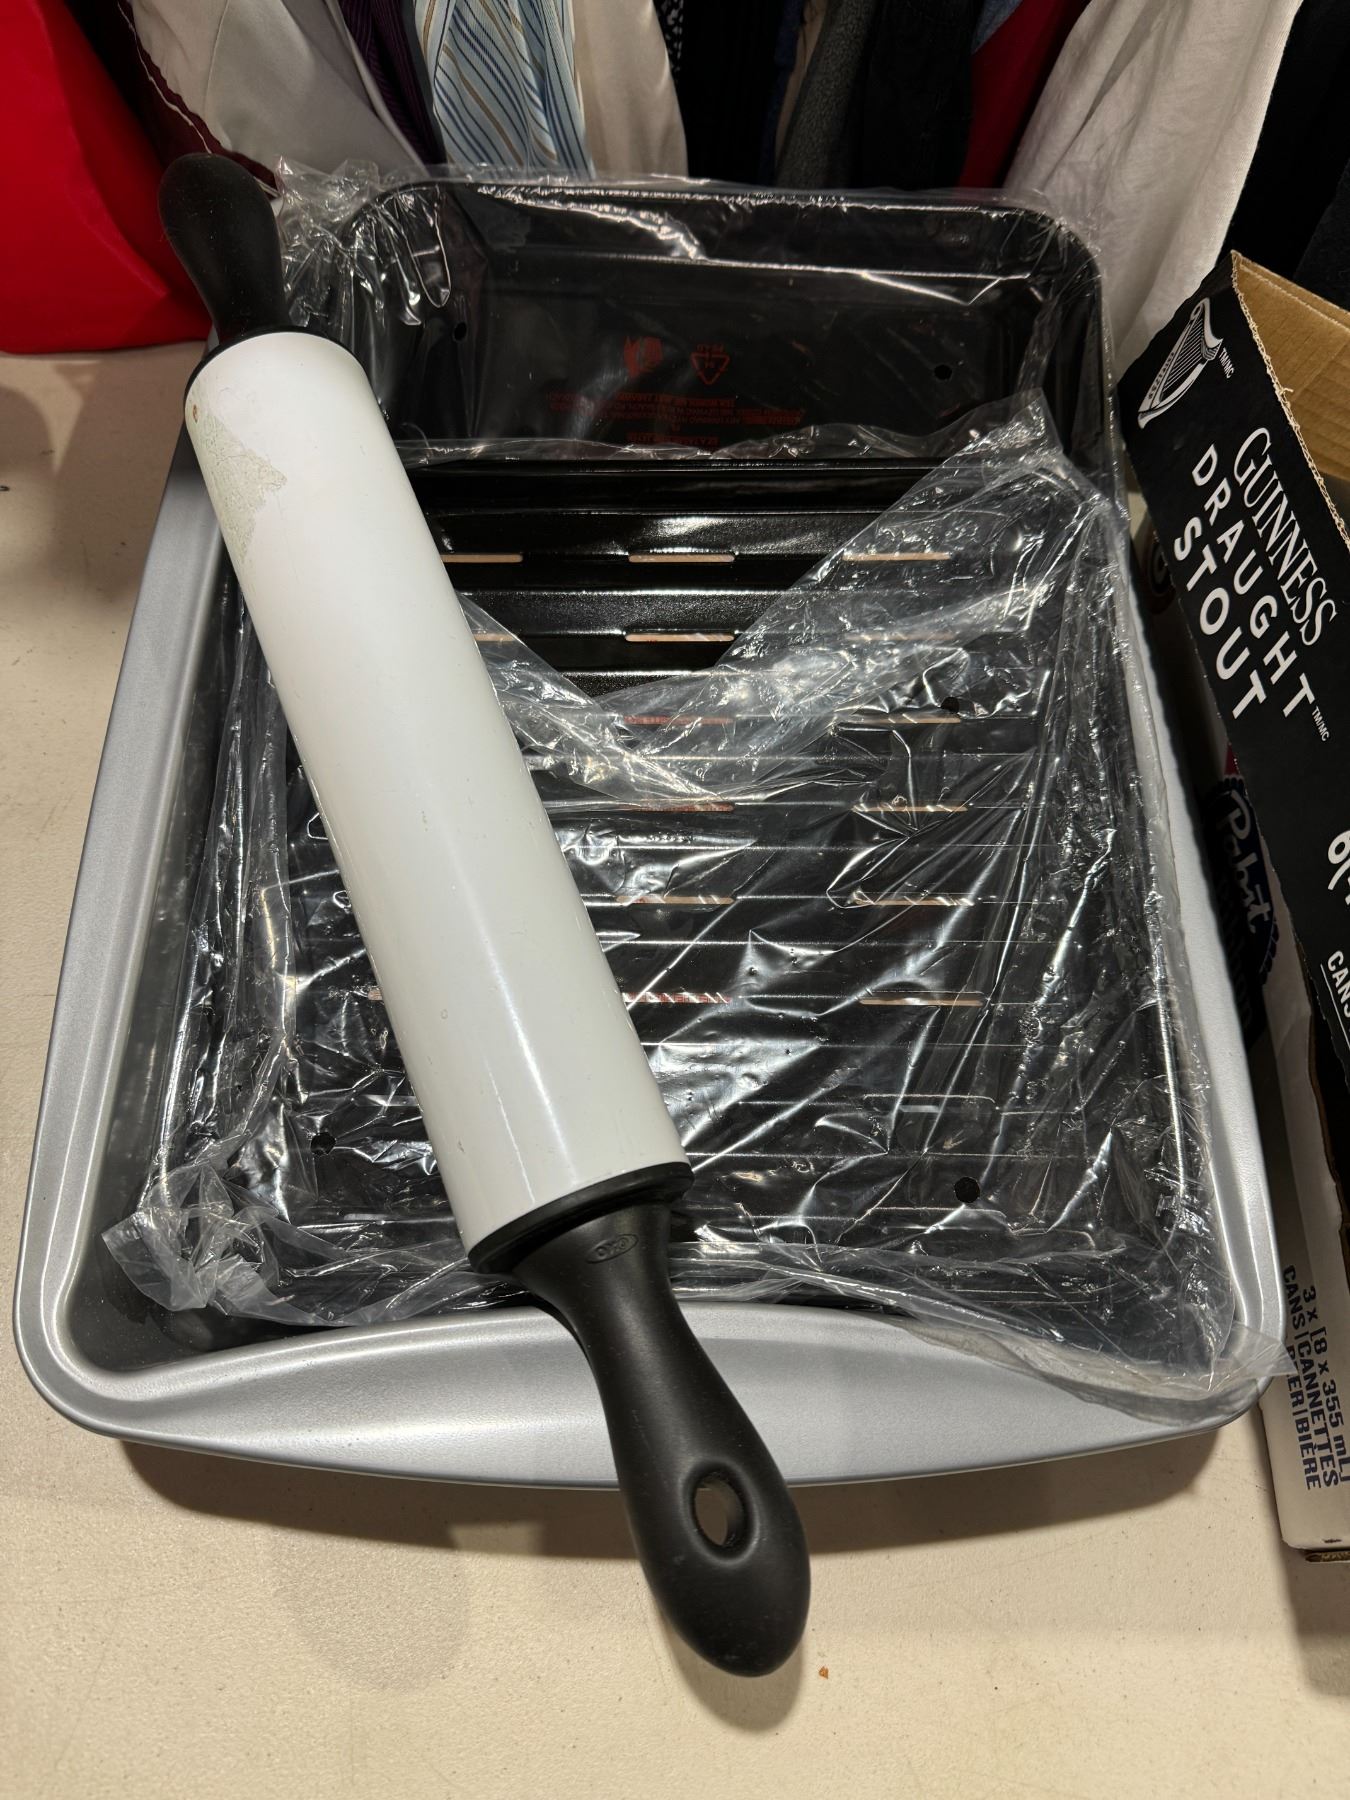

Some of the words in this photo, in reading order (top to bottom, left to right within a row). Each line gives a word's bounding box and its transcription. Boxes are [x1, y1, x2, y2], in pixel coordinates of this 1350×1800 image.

[1233, 427, 1337, 646] GUINNESS
[1191, 444, 1315, 718] DRAUGHT
[1174, 517, 1267, 719] STOUT
[1303, 1285, 1316, 1302] 3
[1306, 1307, 1318, 1322] x
[1318, 1360, 1329, 1376] x
[1322, 1379, 1344, 1428] 355
